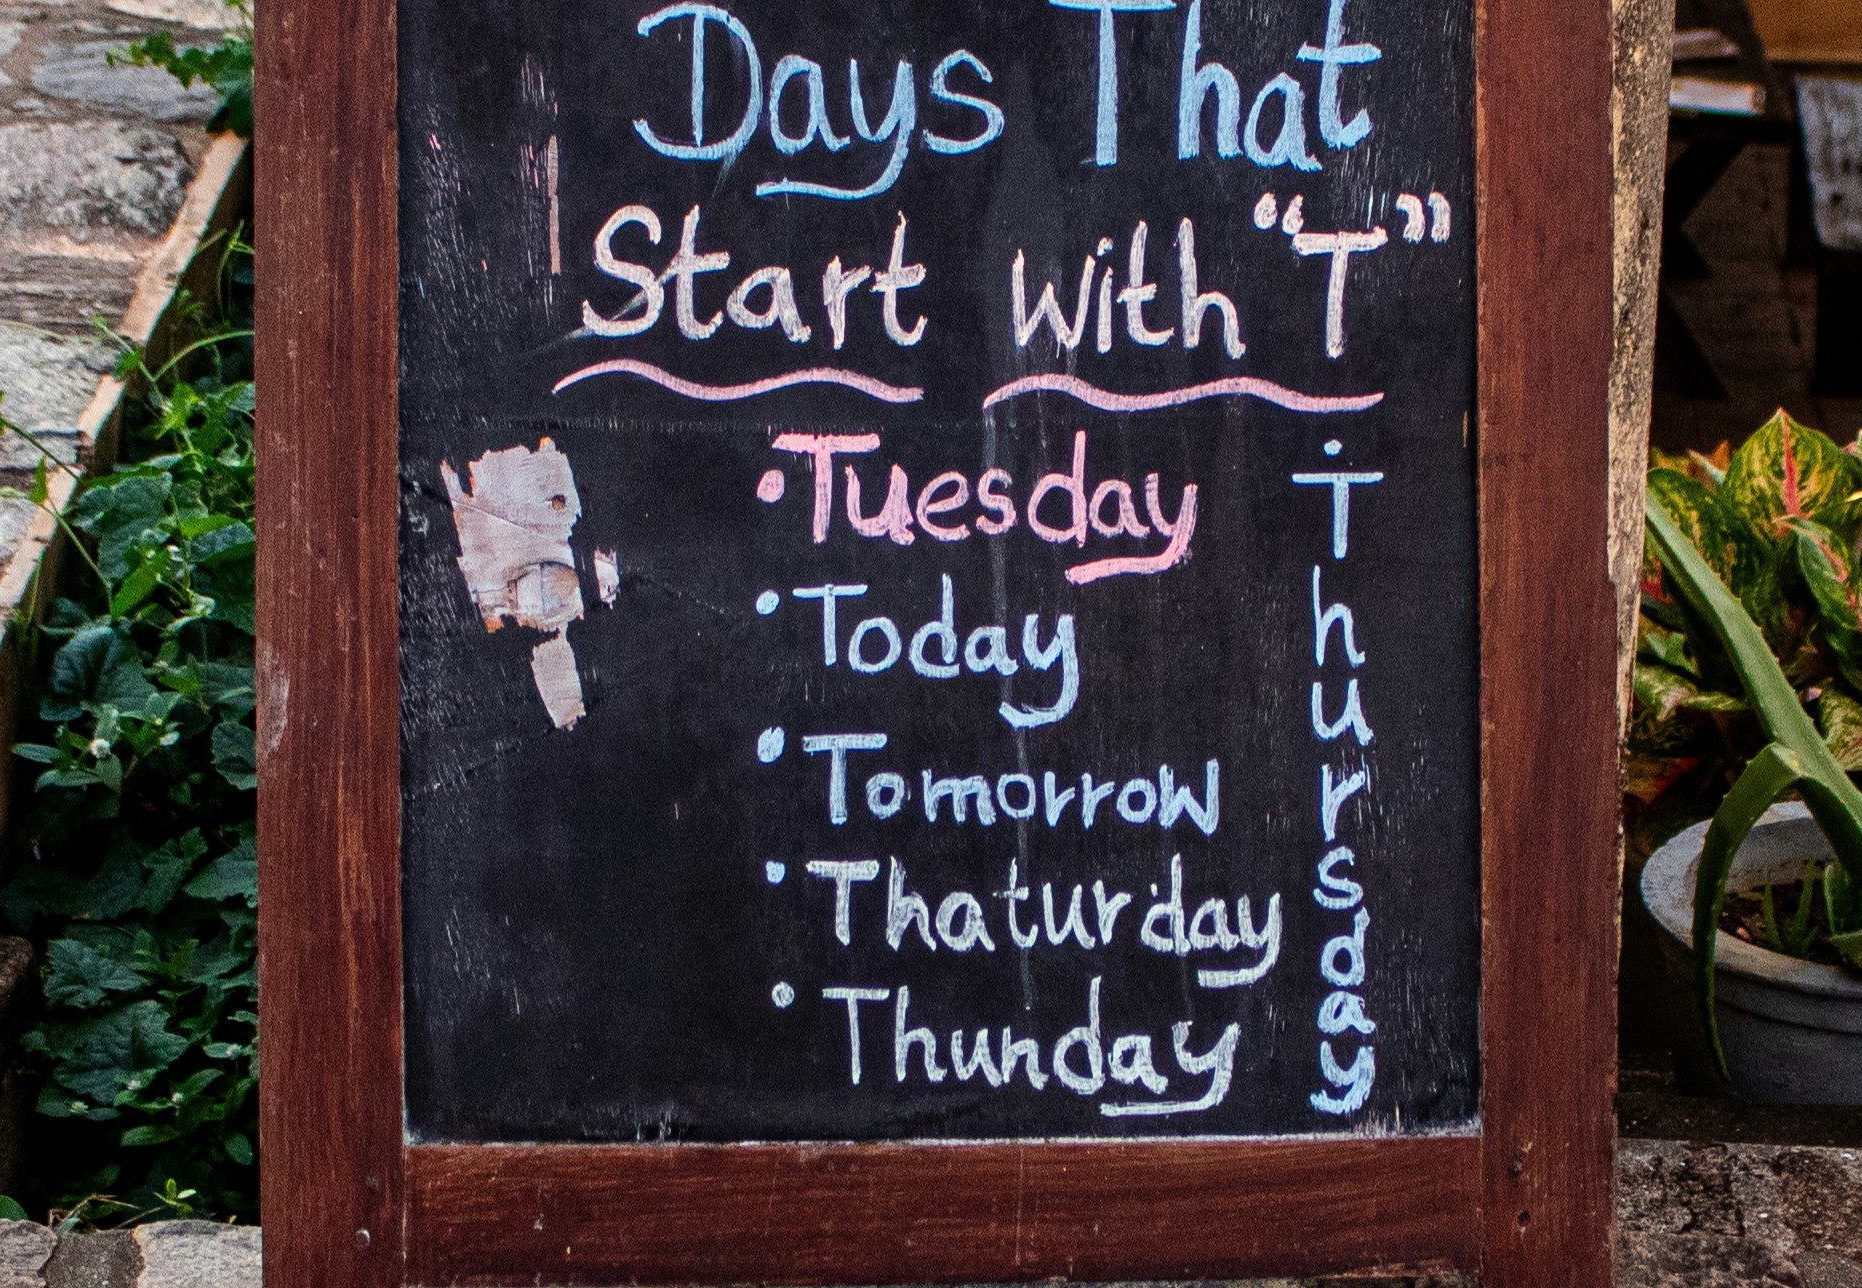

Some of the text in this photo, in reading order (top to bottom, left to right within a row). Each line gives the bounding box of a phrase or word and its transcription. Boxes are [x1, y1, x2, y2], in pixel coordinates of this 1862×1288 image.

[633, 1, 1006, 200] Days
[581, 204, 929, 351] Start
[771, 430, 1198, 586] Tuesday
[792, 573, 1079, 727] Today
[802, 731, 1221, 835] Tomorrow
[1291, 471, 1384, 1114] Thursday
[806, 853, 1283, 986] Thaturday
[821, 975, 1242, 1117] Thunday
